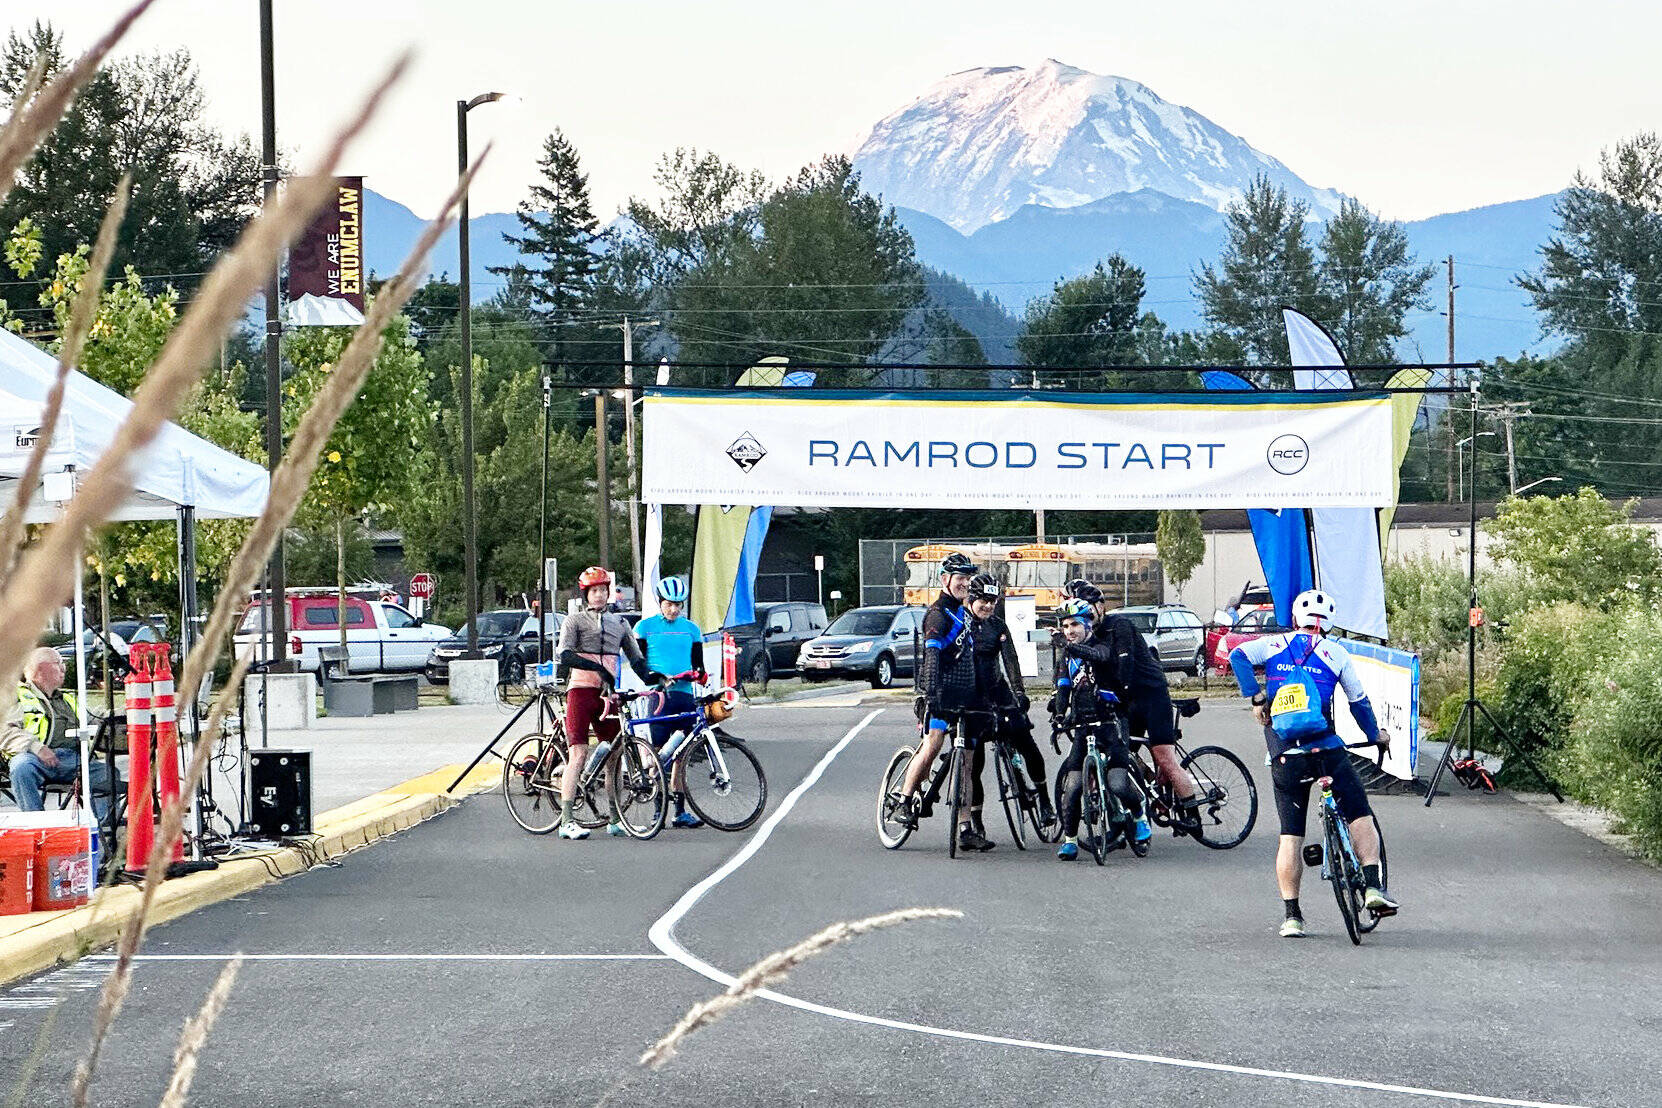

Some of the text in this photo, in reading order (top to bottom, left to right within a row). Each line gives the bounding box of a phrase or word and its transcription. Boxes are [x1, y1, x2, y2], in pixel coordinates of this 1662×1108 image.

[339, 187, 360, 295] ENUMCLAW
[327, 233, 340, 295] WE ARE
[809, 440, 1226, 470] RAMROD START
[1272, 449, 1304, 459] RCC
[412, 582, 432, 592] STOP
[1279, 694, 1295, 706] 330
